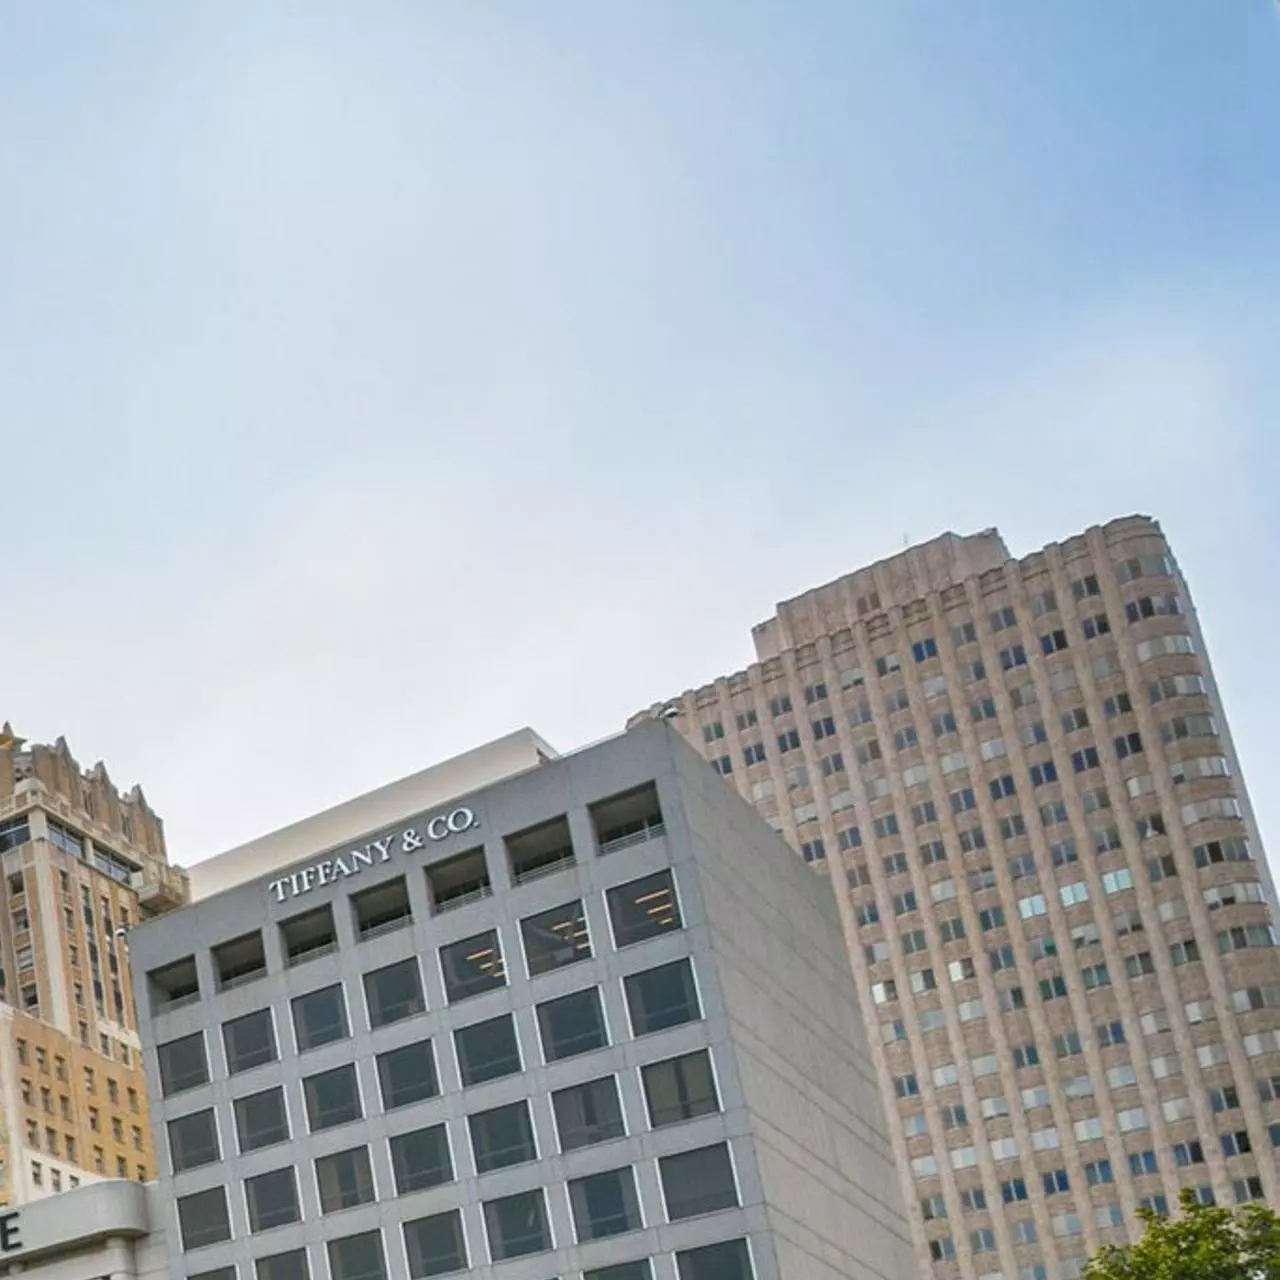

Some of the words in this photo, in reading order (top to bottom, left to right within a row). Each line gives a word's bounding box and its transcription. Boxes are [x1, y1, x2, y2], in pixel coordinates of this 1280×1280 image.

[269, 836, 394, 902] TIFFANY
[402, 828, 425, 852] &
[428, 807, 481, 841] CO.
